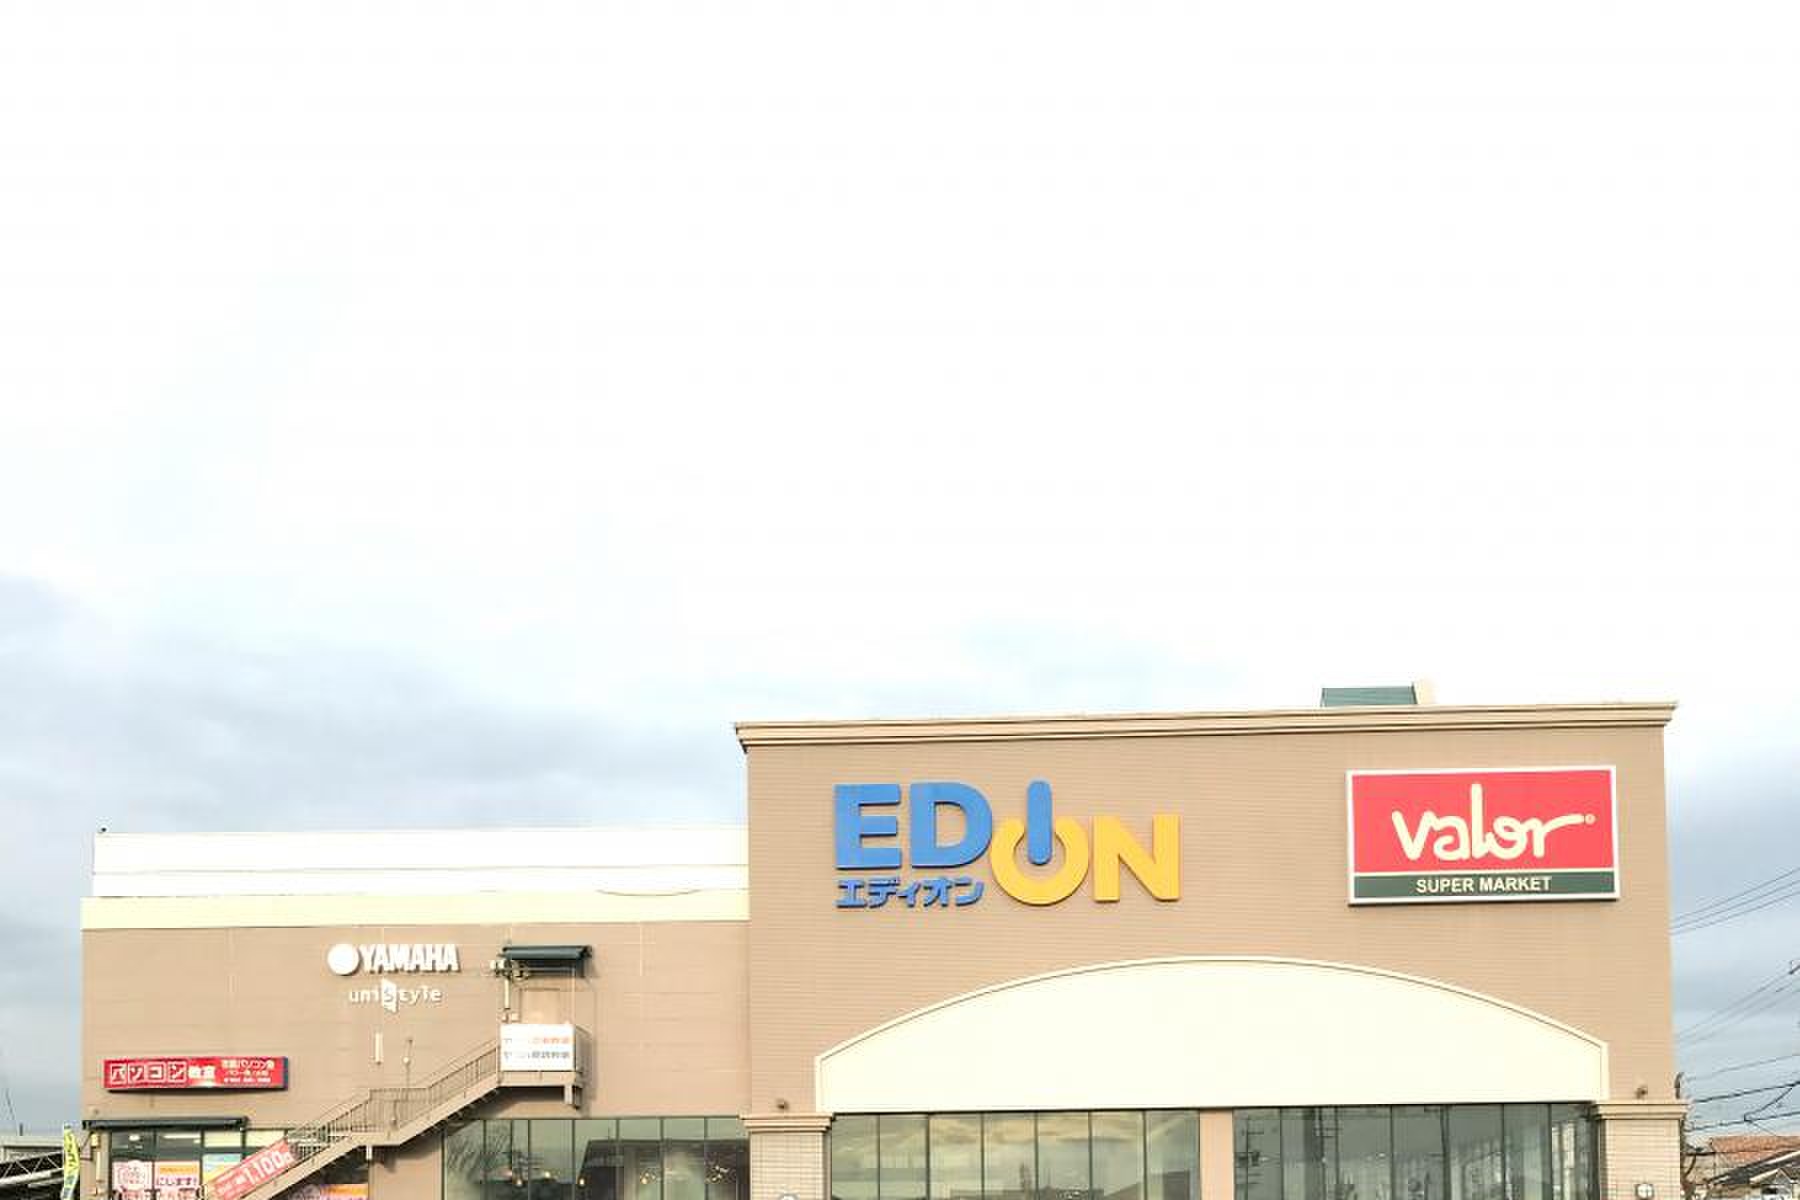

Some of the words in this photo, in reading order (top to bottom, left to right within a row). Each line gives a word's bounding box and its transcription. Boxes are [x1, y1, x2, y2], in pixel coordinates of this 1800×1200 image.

[833, 779, 1182, 906] EDION
[835, 877, 985, 908] エディオン
[1416, 877, 1474, 893] SUPER
[1479, 876, 1552, 892] MARKET
[358, 943, 460, 973] YAMAHA
